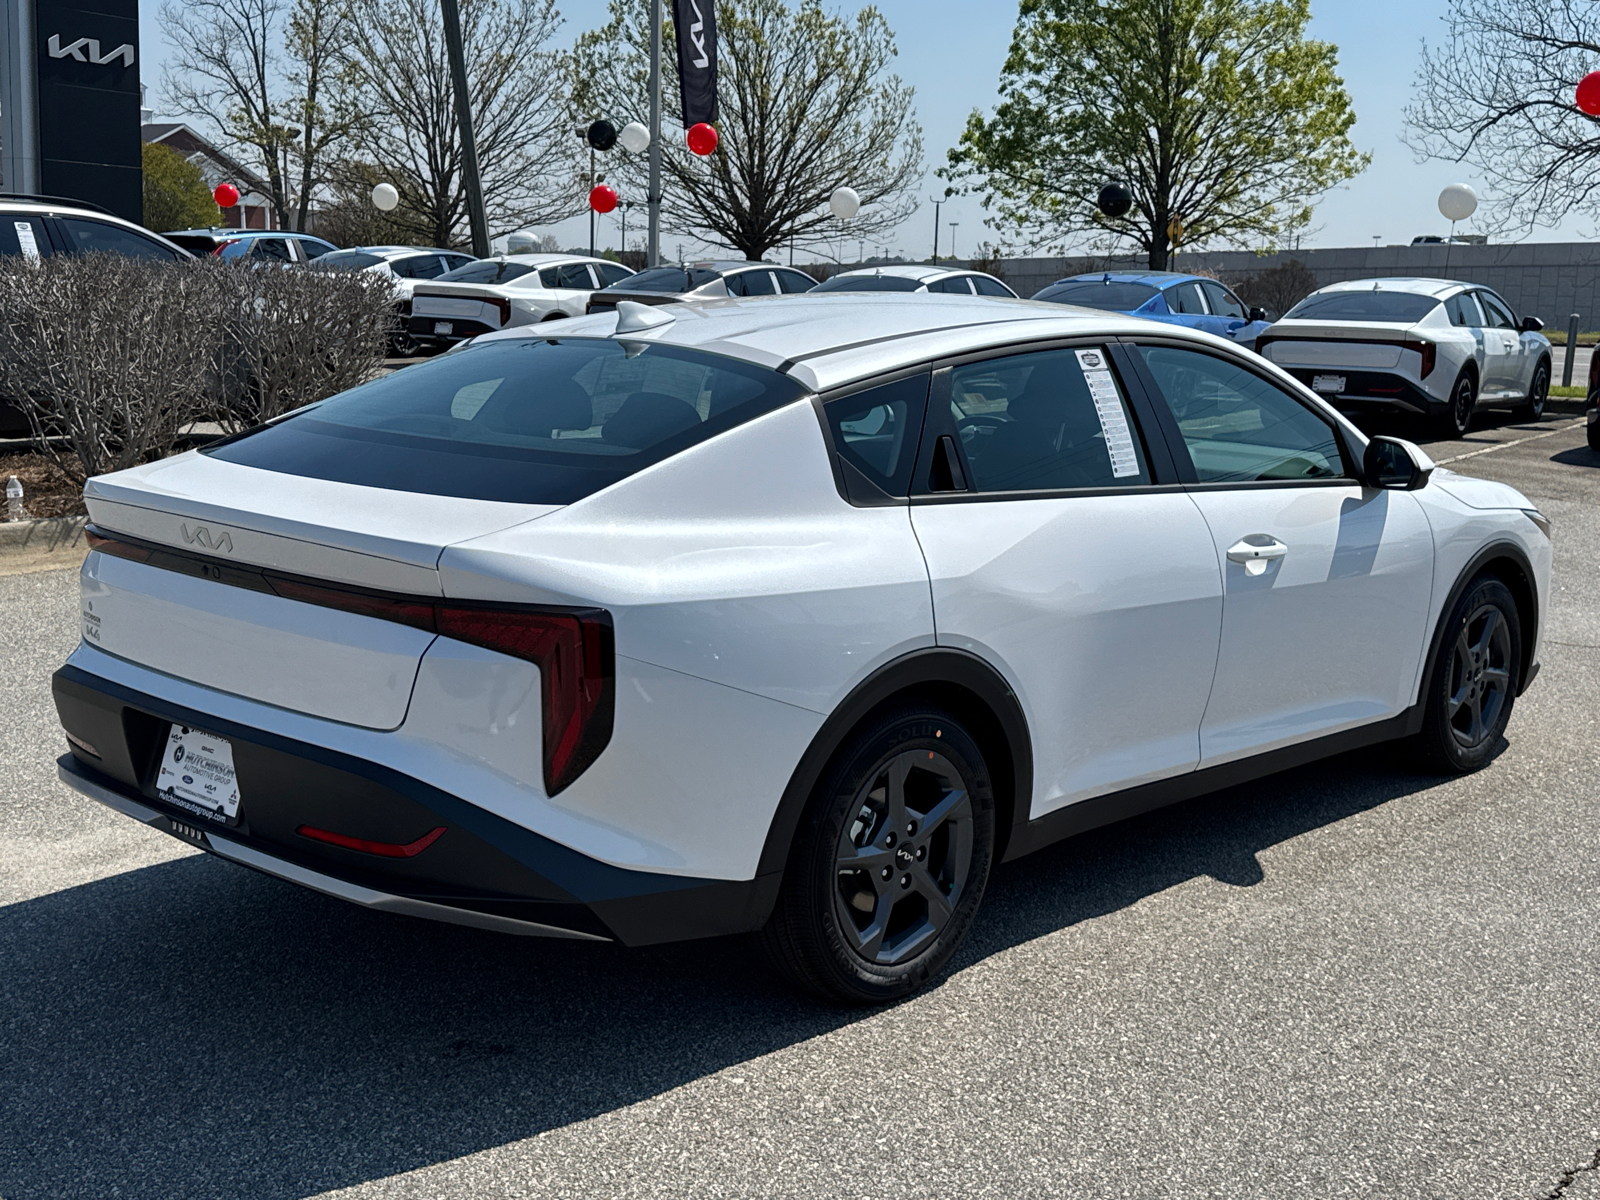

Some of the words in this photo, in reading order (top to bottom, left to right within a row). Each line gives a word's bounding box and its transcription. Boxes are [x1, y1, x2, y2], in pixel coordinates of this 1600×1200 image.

[47, 33, 135, 68] KIA
[180, 523, 233, 553] KIA
[183, 764, 214, 780] AUTOMOTIVE
[214, 774, 231, 785] GROUP
[185, 753, 235, 778] HUTCHINSON
[204, 783, 217, 792] KIA
